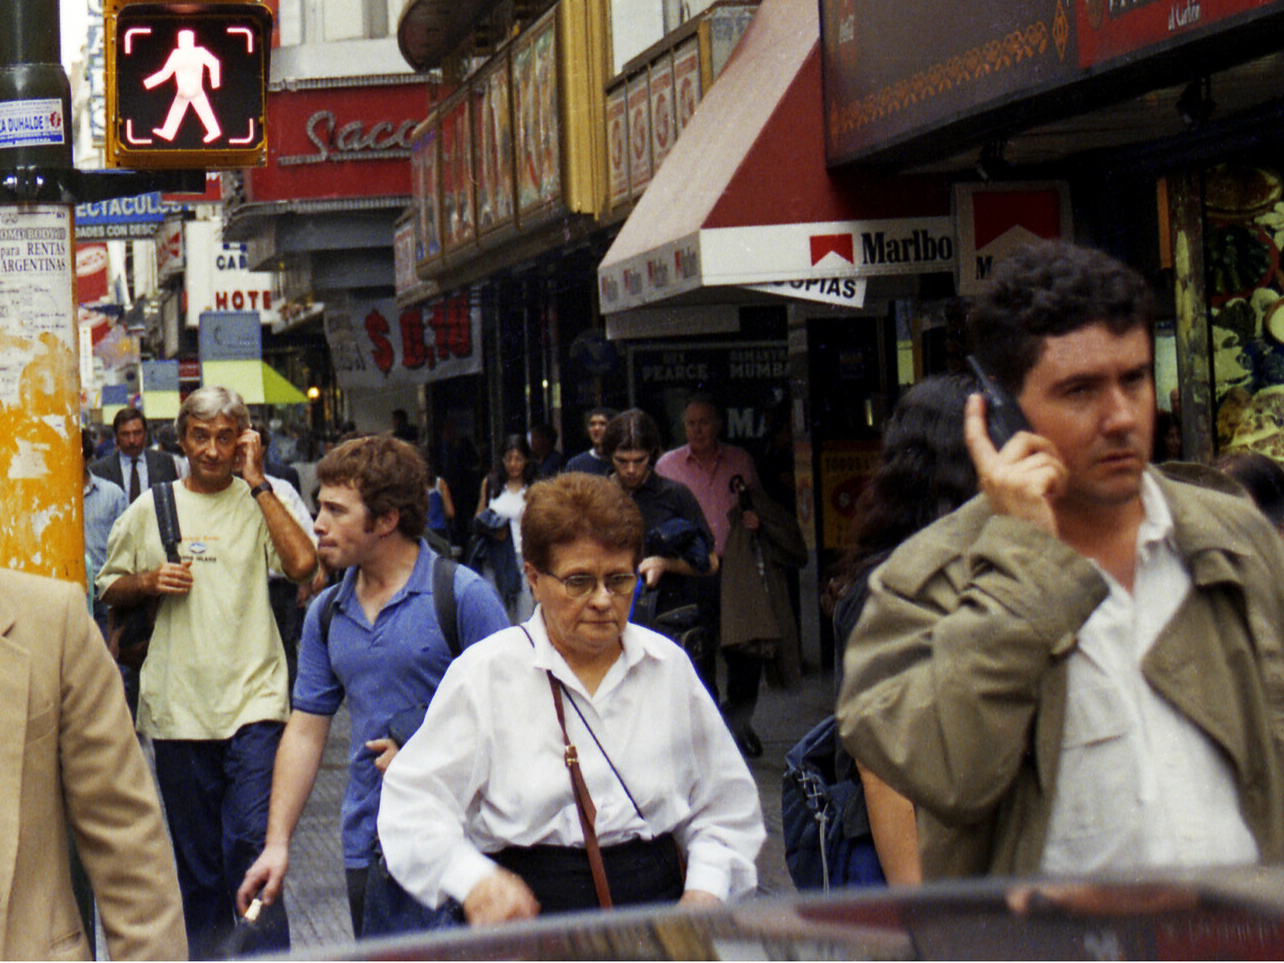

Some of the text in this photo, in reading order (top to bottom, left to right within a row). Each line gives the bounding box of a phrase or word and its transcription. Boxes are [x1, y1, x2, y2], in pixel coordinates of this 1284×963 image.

[1, 247, 20, 260] para
[27, 242, 66, 256] RENTAS
[862, 230, 953, 265] Marlbo
[0, 258, 66, 273] ARGENTINAS
